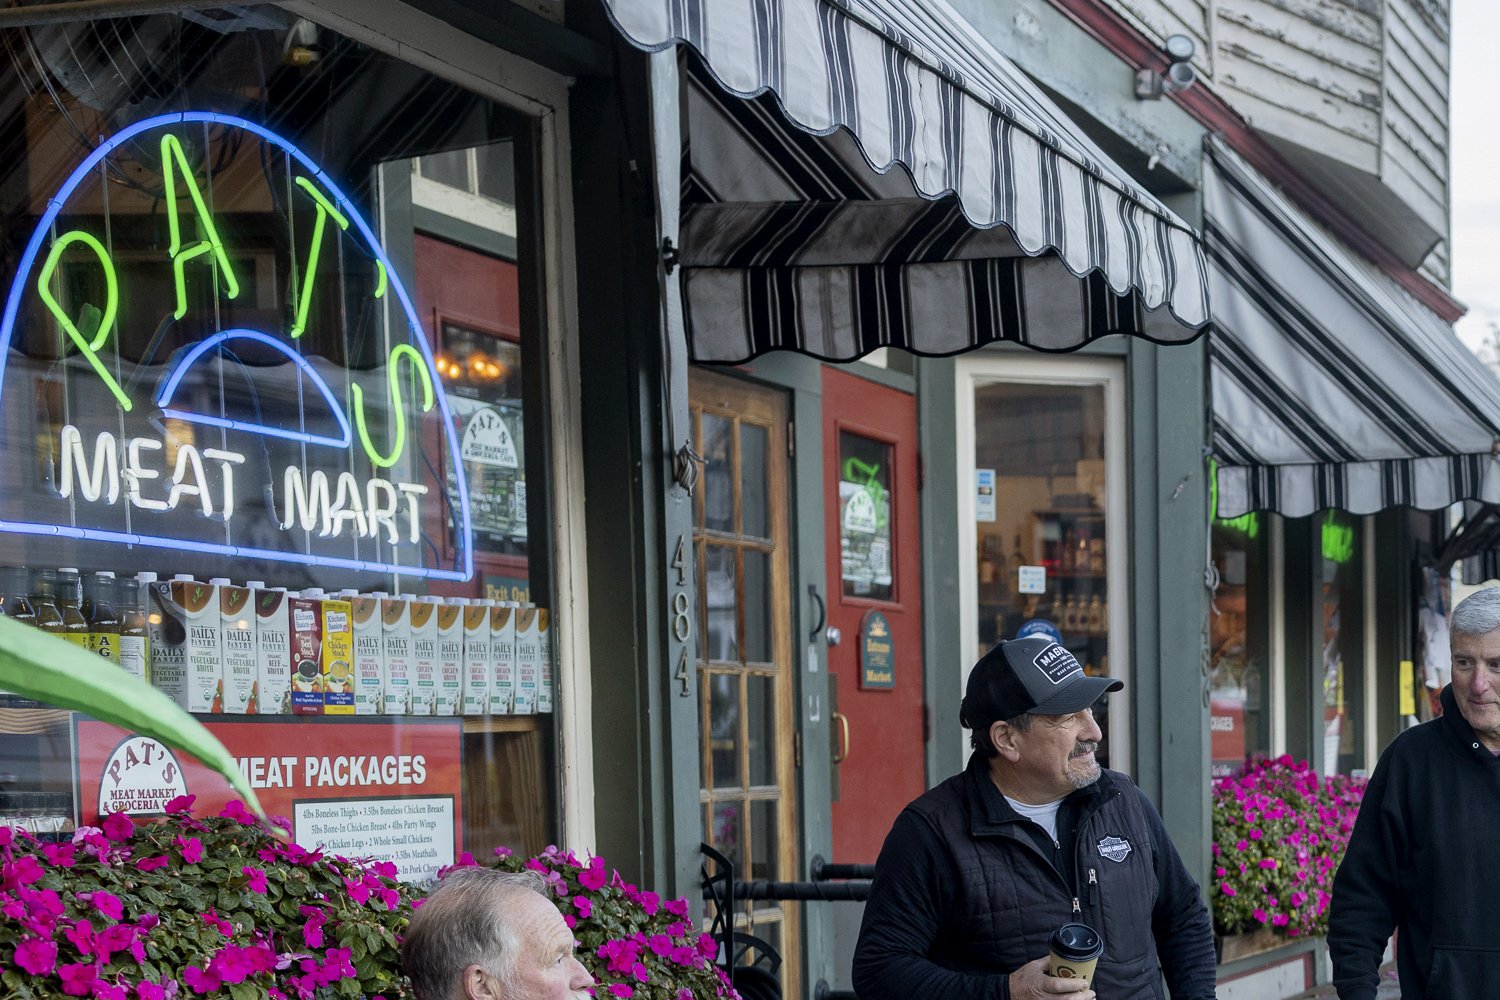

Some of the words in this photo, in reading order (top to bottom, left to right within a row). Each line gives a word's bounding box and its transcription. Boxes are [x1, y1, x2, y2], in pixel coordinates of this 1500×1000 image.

[38, 133, 434, 468] PAT'S
[470, 414, 508, 445] PAT'S
[59, 424, 246, 522] MEAT
[279, 464, 429, 545] MART
[486, 584, 508, 600] Exit
[512, 586, 530, 602] Onl
[671, 531, 691, 698] 484
[191, 626, 216, 639] DAILY
[227, 629, 251, 641] DAILY
[262, 631, 285, 643] DAILY
[191, 639, 216, 647] PANTRY
[301, 639, 312, 648] Beef
[358, 636, 379, 648] DAILY
[388, 637, 407, 649] DAILY
[415, 640, 434, 651] DAILY
[442, 642, 459, 653] DAILY
[469, 642, 487, 653] DAILY
[494, 642, 511, 653] DAILY
[153, 648, 185, 656] DAILY
[520, 644, 535, 654] DAILY
[190, 656, 219, 665] VEGETABLE
[226, 658, 255, 666] VEGETABLE
[108, 741, 176, 788] PAT'S
[305, 755, 427, 787] PACKAGES
[110, 789, 135, 800] MEAT
[138, 788, 176, 799] MARKET
[103, 802, 111, 812] &
[303, 810, 314, 819] 4lbs
[315, 808, 339, 818] Boneless
[340, 808, 358, 819] Thighs
[363, 807, 379, 816] 3.5lbs
[380, 805, 402, 815] Boneless
[404, 804, 426, 814] Chicken
[427, 804, 444, 813] Breast
[311, 825, 322, 834] 5lbs
[324, 824, 346, 833] Bone-In
[347, 823, 369, 832] Chicken
[370, 822, 387, 831] Breast
[392, 820, 403, 830] 4lbs
[404, 820, 418, 830] Party
[420, 820, 436, 830] Wings
[328, 840, 350, 849] Chicken
[352, 839, 364, 849] Legs
[369, 838, 372, 846] 2
[374, 837, 390, 846] Whole
[392, 836, 406, 844] Small
[408, 835, 432, 844] Chickens
[395, 850, 410, 859] 3.5lbs
[412, 849, 437, 858] Meatballs
[410, 864, 421, 874] Pork
